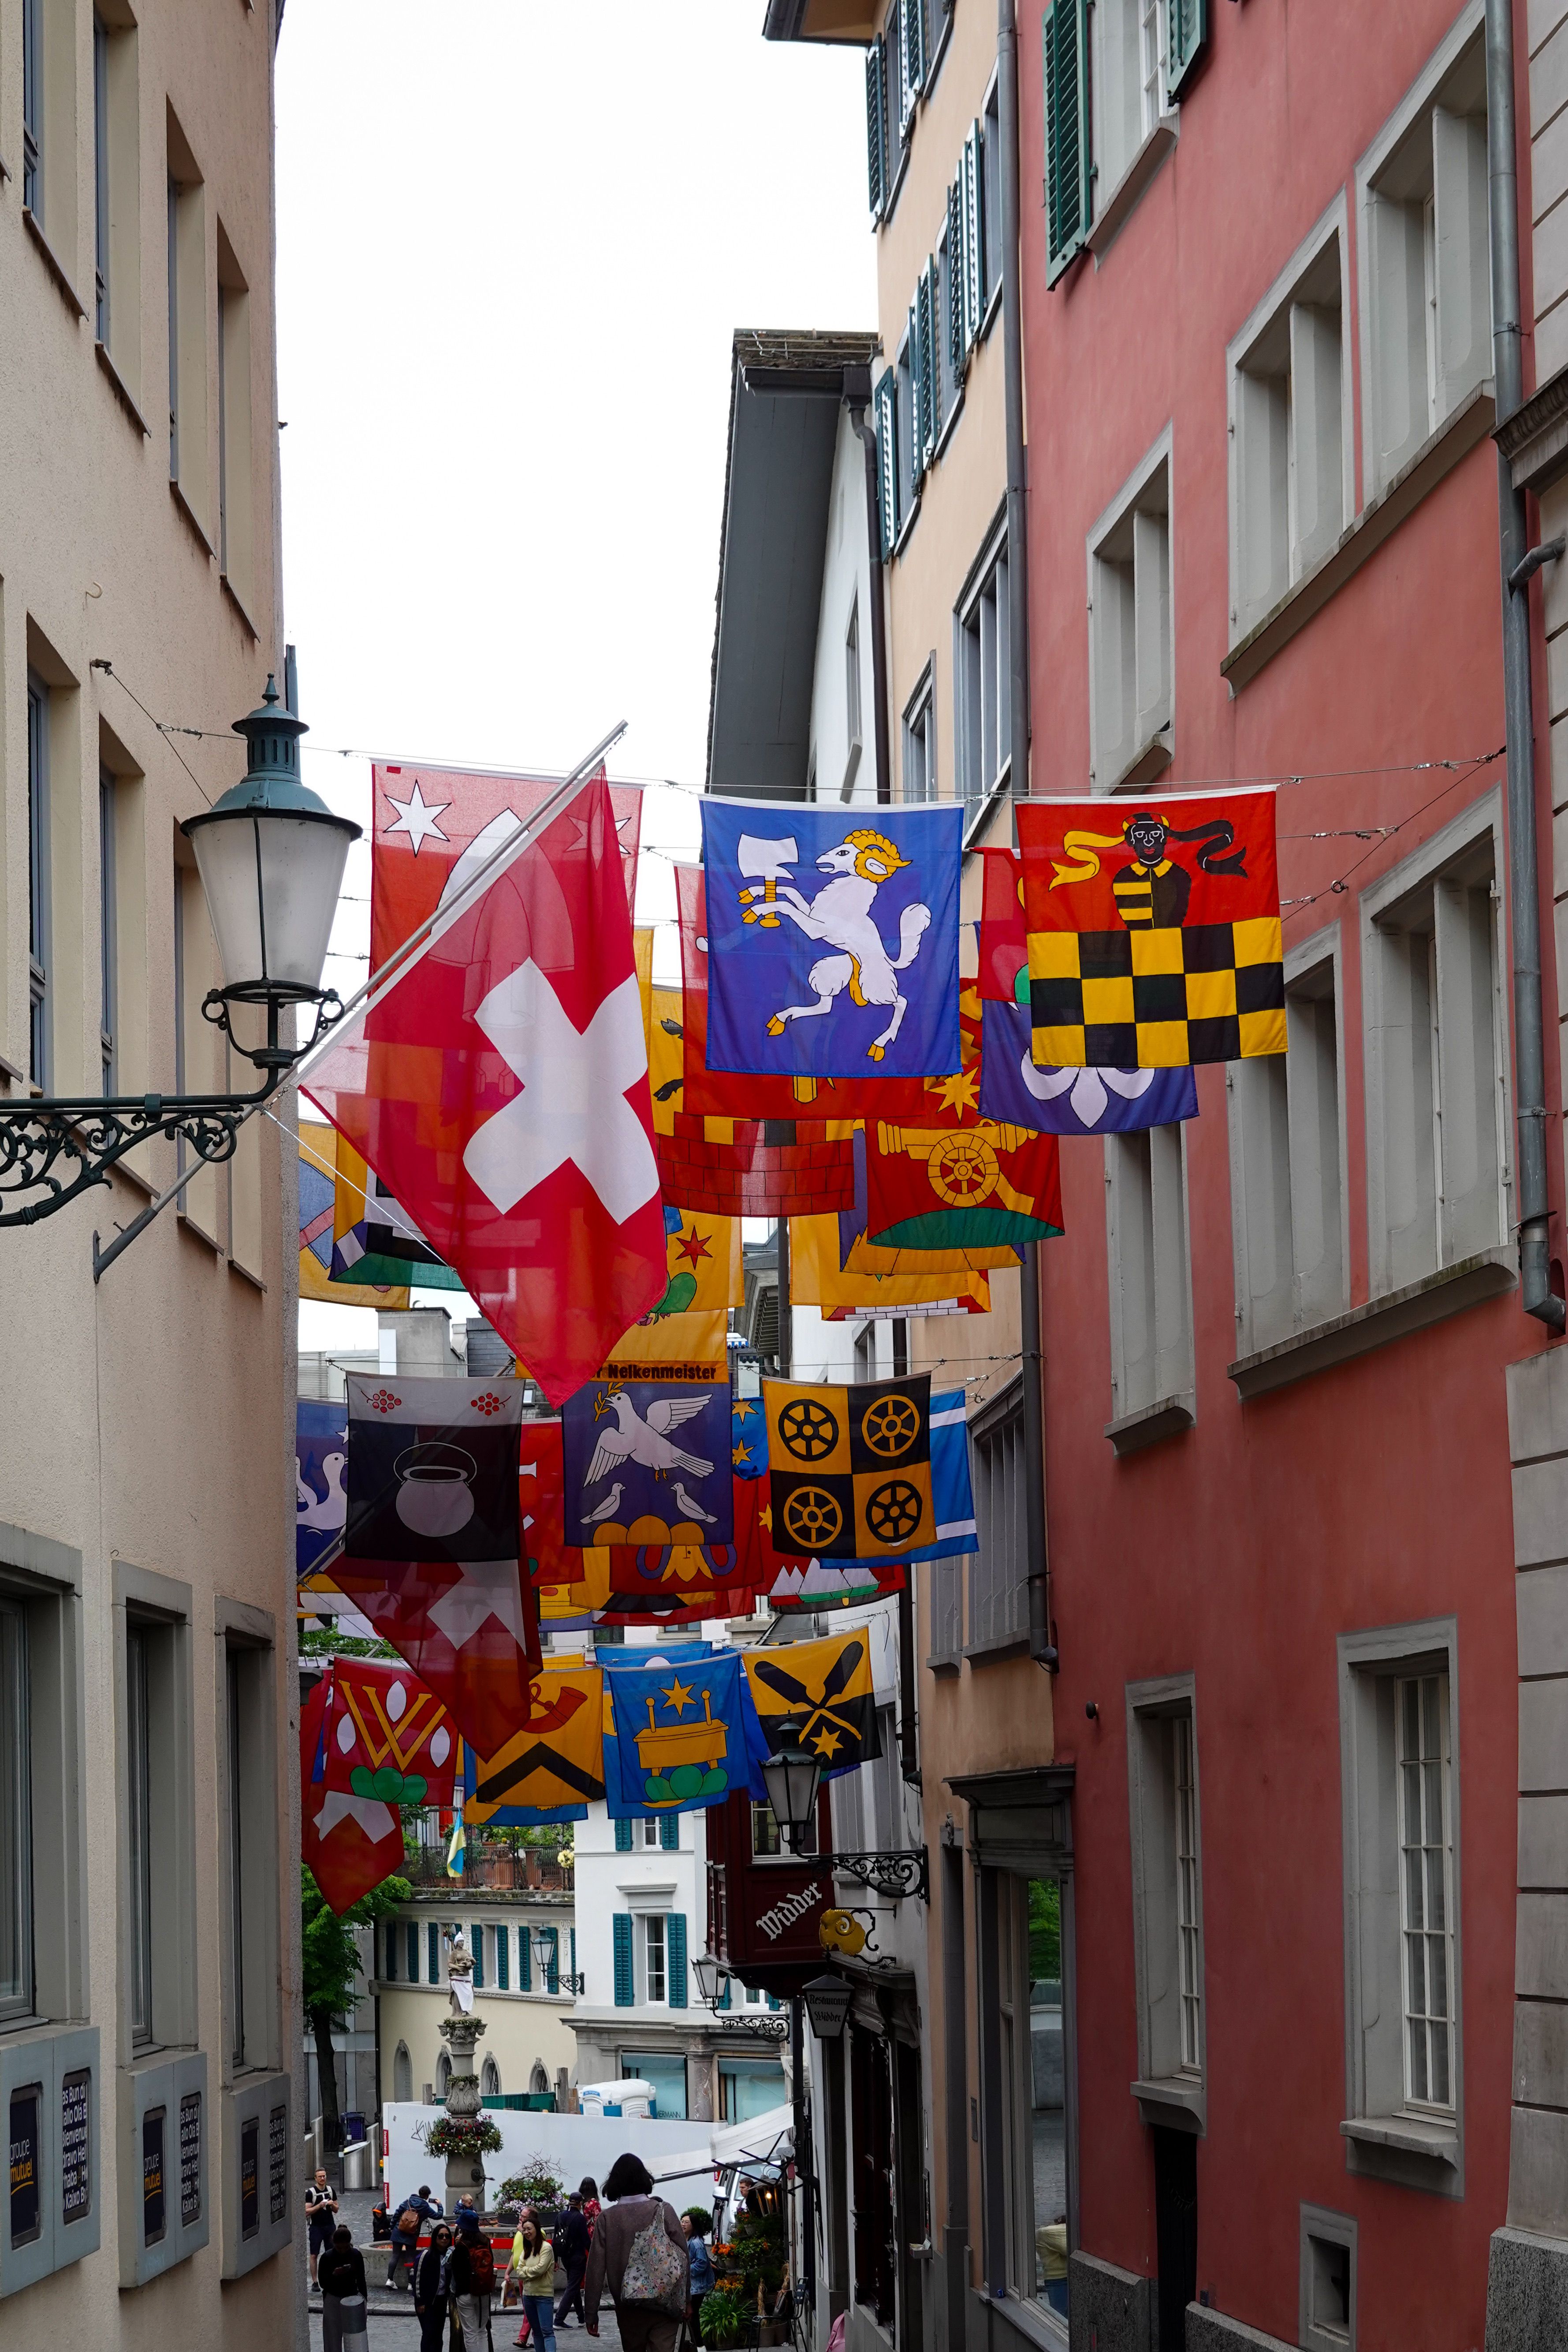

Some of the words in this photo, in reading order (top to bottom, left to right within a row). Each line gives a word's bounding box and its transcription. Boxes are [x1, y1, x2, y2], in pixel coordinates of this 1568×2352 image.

[608, 1364, 716, 1379] Nelkenmeister
[756, 1882, 822, 1941] Widder
[809, 1994, 849, 2006] Restaurant
[814, 2011, 841, 2022] Widder
[69, 2086, 79, 2103] Bun
[80, 2082, 86, 2099] di
[63, 2107, 73, 2127] allo
[74, 2101, 82, 2122] Olá
[10, 2139, 30, 2165] groupe
[11, 2158, 32, 2184] mutuel
[144, 2153, 159, 2176] groupe
[145, 2169, 161, 2192] mutuel
[66, 2189, 80, 2209] Kaixo
